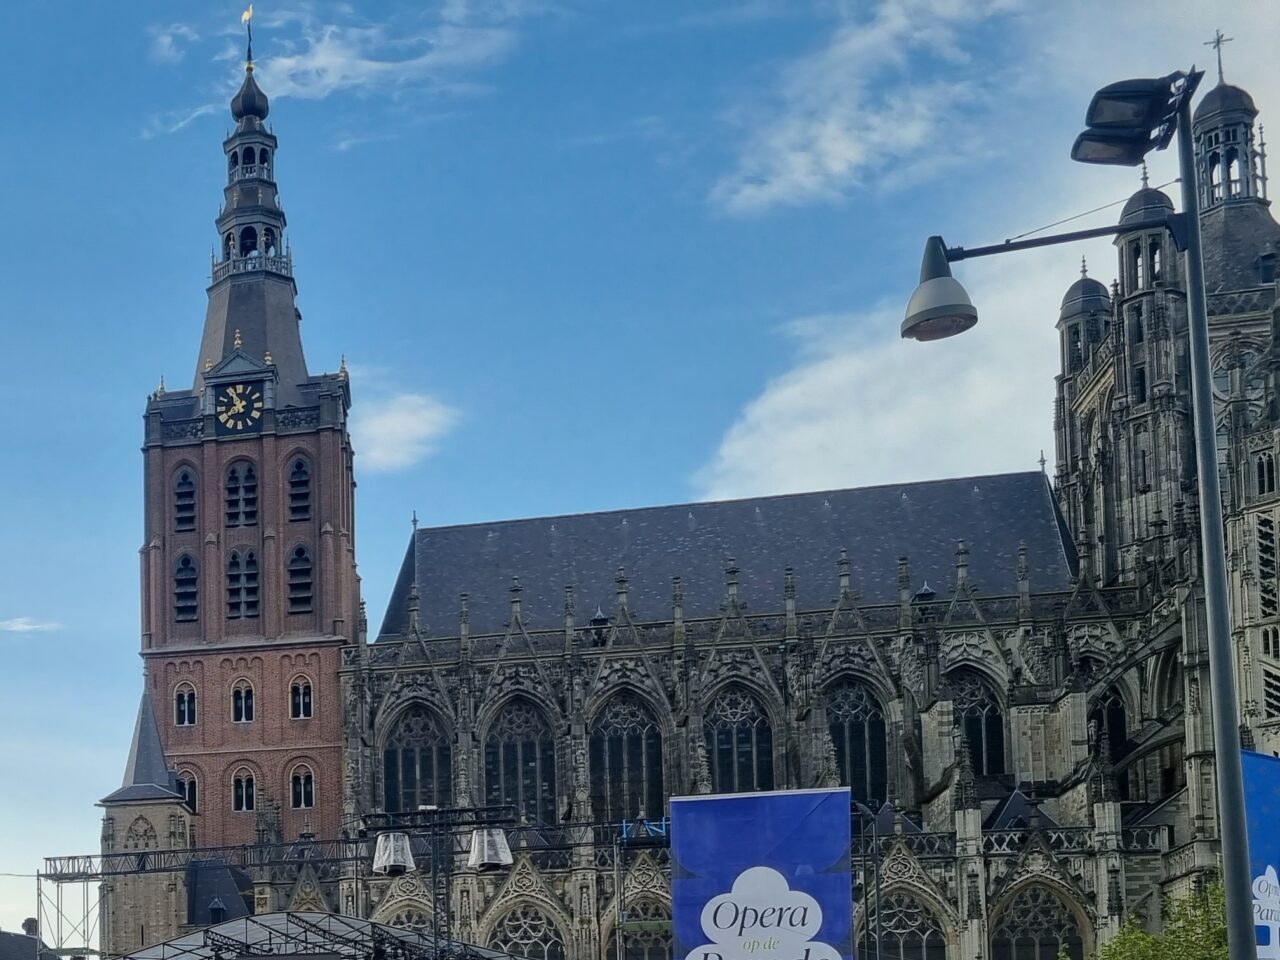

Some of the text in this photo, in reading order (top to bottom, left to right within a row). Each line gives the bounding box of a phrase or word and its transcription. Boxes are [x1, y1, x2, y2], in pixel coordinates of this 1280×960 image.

[712, 901, 809, 937] Opera
[742, 937, 780, 953] op de
